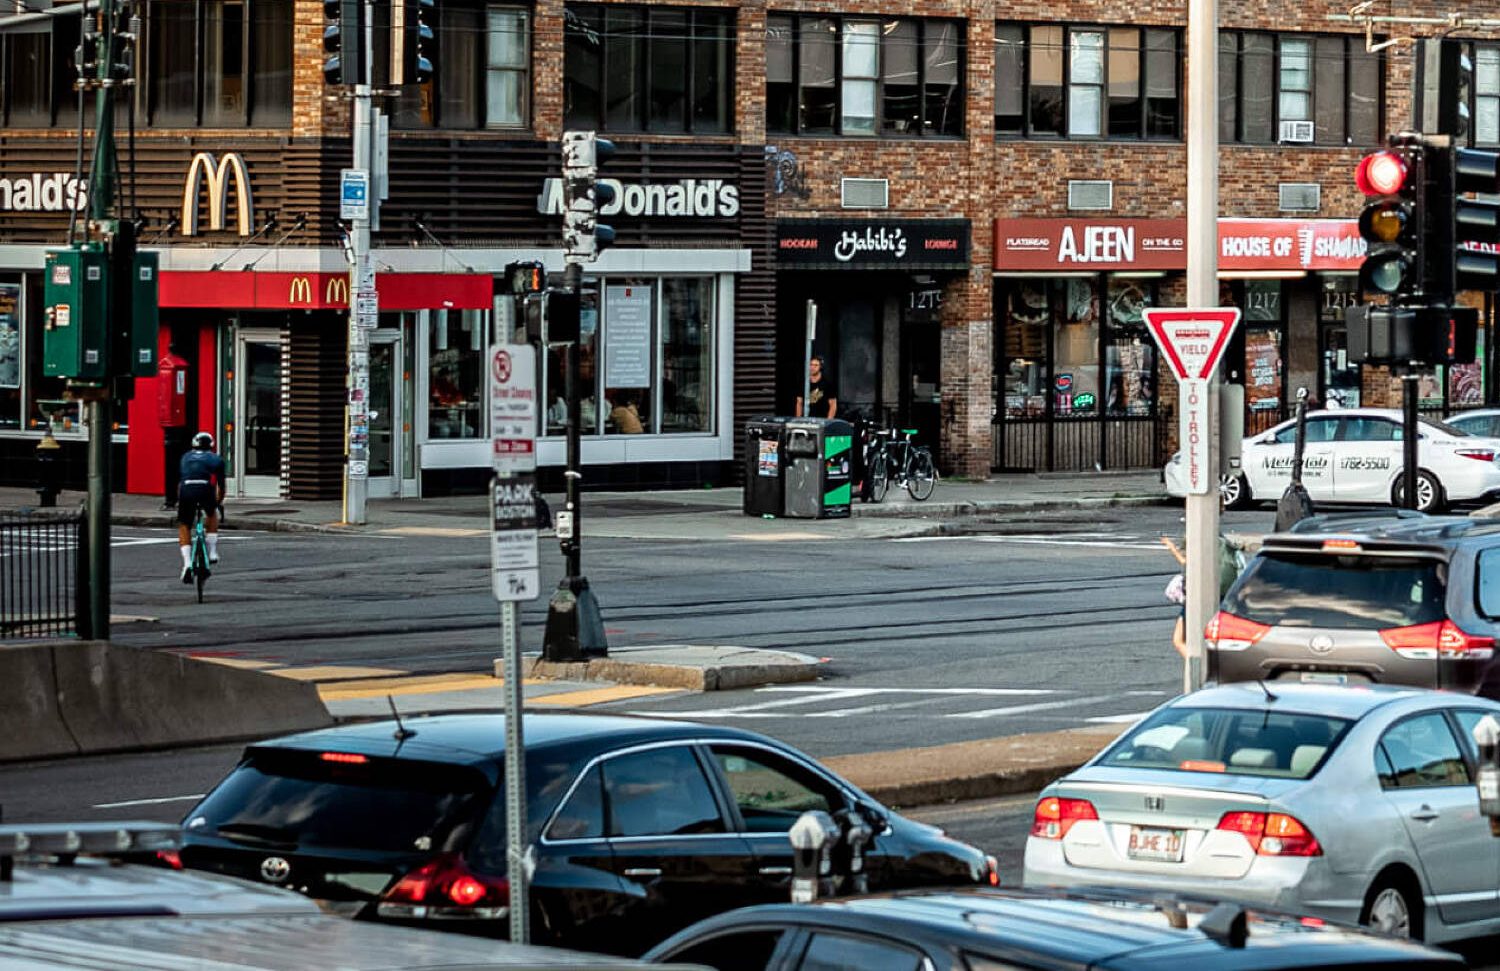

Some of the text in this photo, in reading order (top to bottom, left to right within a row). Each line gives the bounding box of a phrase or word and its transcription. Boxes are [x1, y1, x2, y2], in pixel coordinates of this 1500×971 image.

[780, 226, 958, 261] HOOKAH Habibi's LOUNGE
[1006, 238, 1049, 246] FLATBREAD
[1057, 226, 1135, 263] AJEEN
[1222, 237, 1271, 257] HOUSE
[1273, 237, 1292, 257] OF
[1246, 292, 1280, 310] 1217
[1326, 292, 1357, 310] 1215
[1180, 345, 1208, 355] YIELD
[496, 484, 534, 504] PARK
